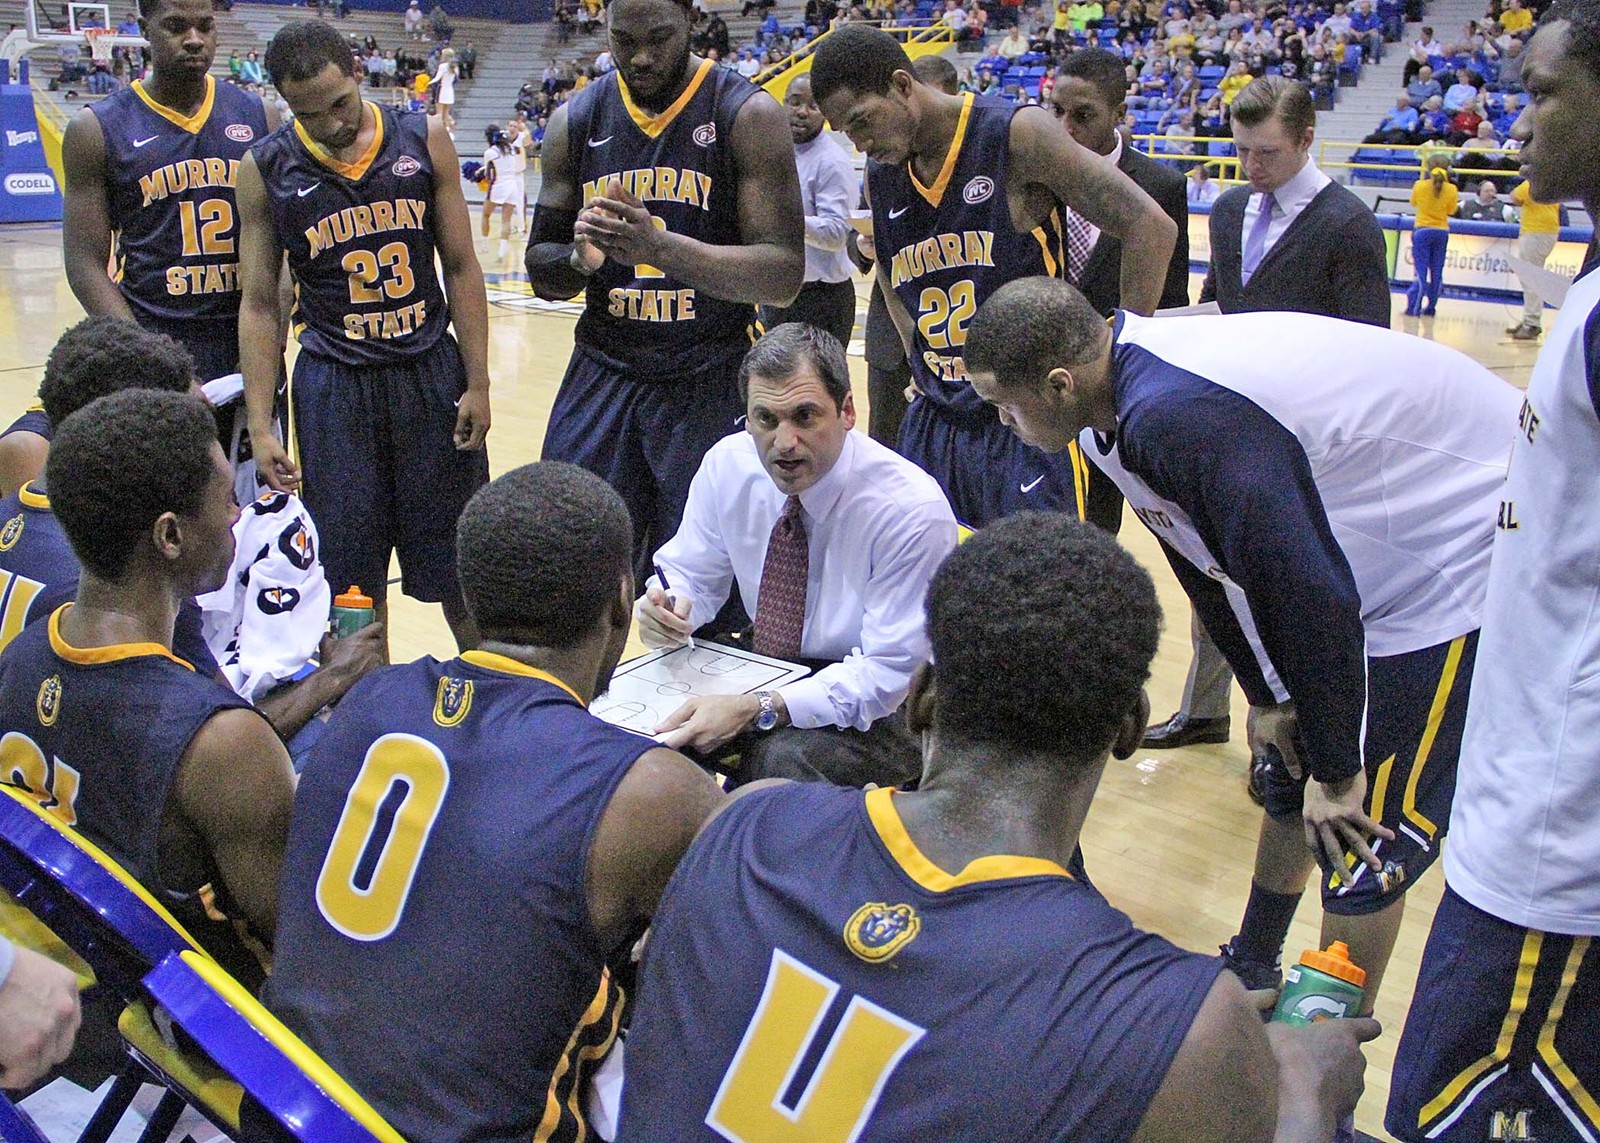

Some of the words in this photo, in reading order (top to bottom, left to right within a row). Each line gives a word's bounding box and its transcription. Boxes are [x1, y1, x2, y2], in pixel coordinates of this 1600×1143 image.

[10, 179, 51, 189] CODELL
[138, 157, 240, 207] MURR
[178, 198, 235, 257] 12
[305, 199, 426, 259] MURRAY
[341, 241, 415, 304] 23
[891, 231, 996, 289] MURRAY
[1445, 250, 1515, 275] Morehea
[343, 300, 426, 340] STATE
[608, 288, 696, 322] STATE
[917, 279, 977, 349] 22
[923, 351, 972, 382] STA
[1518, 398, 1540, 445] ATE
[316, 732, 450, 942] 0
